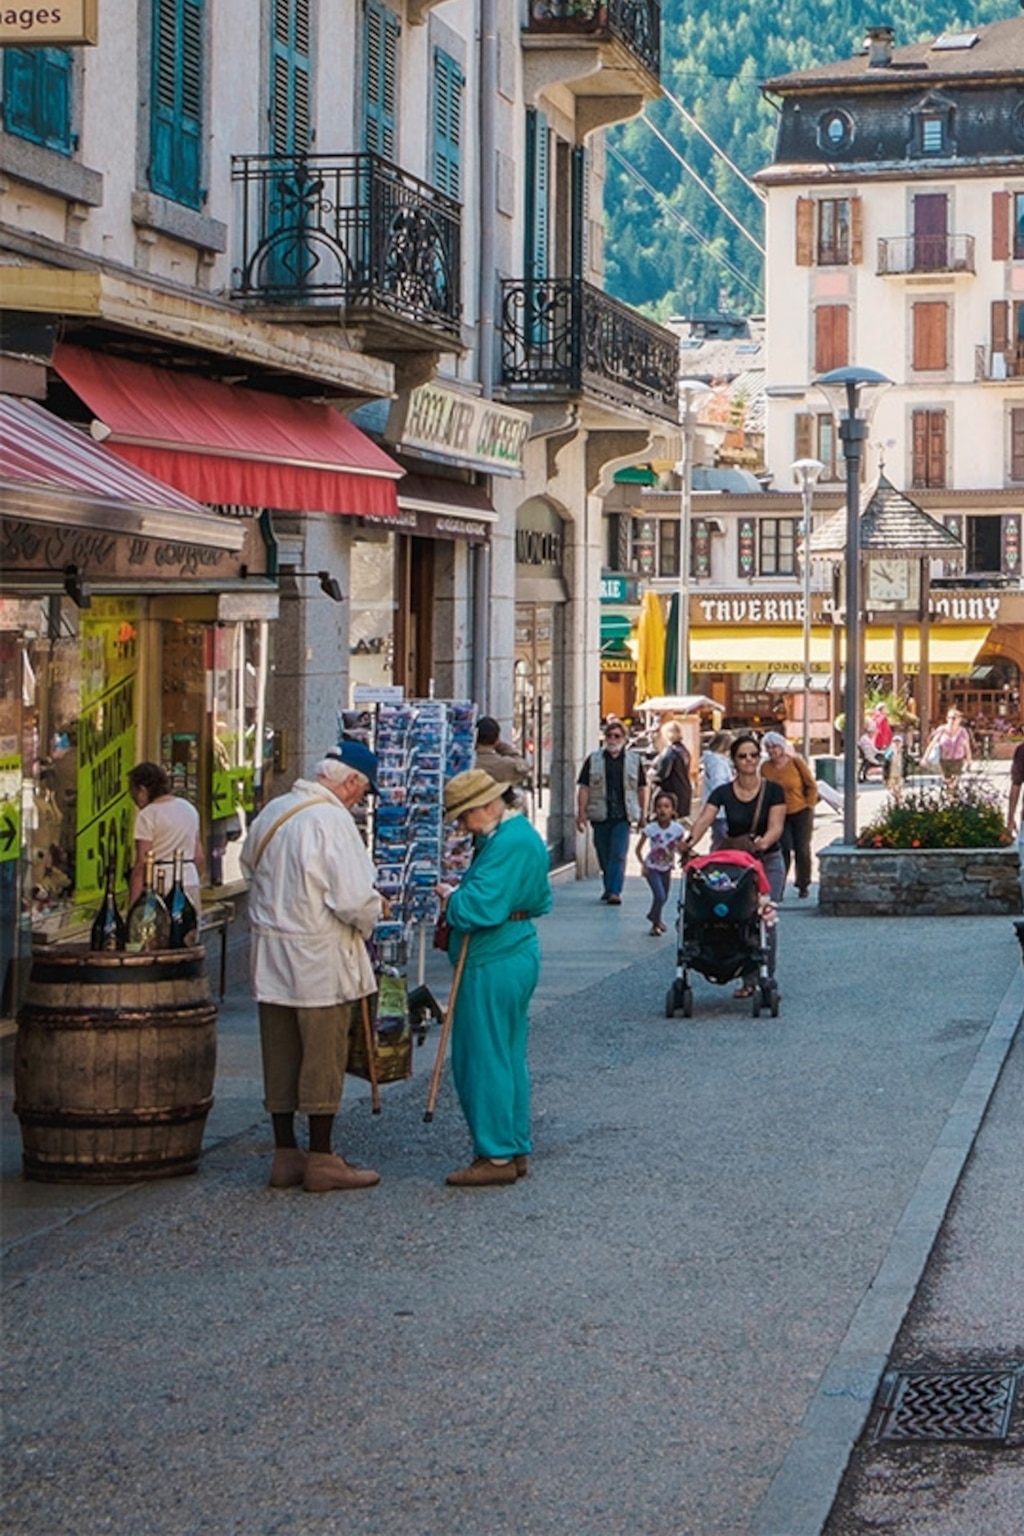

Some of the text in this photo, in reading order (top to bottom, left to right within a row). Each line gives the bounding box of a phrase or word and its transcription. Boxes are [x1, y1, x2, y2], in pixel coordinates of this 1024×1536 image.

[0, 8, 61, 30] ages
[699, 598, 806, 622] TAVERNE
[767, 663, 822, 672] FONDUS
